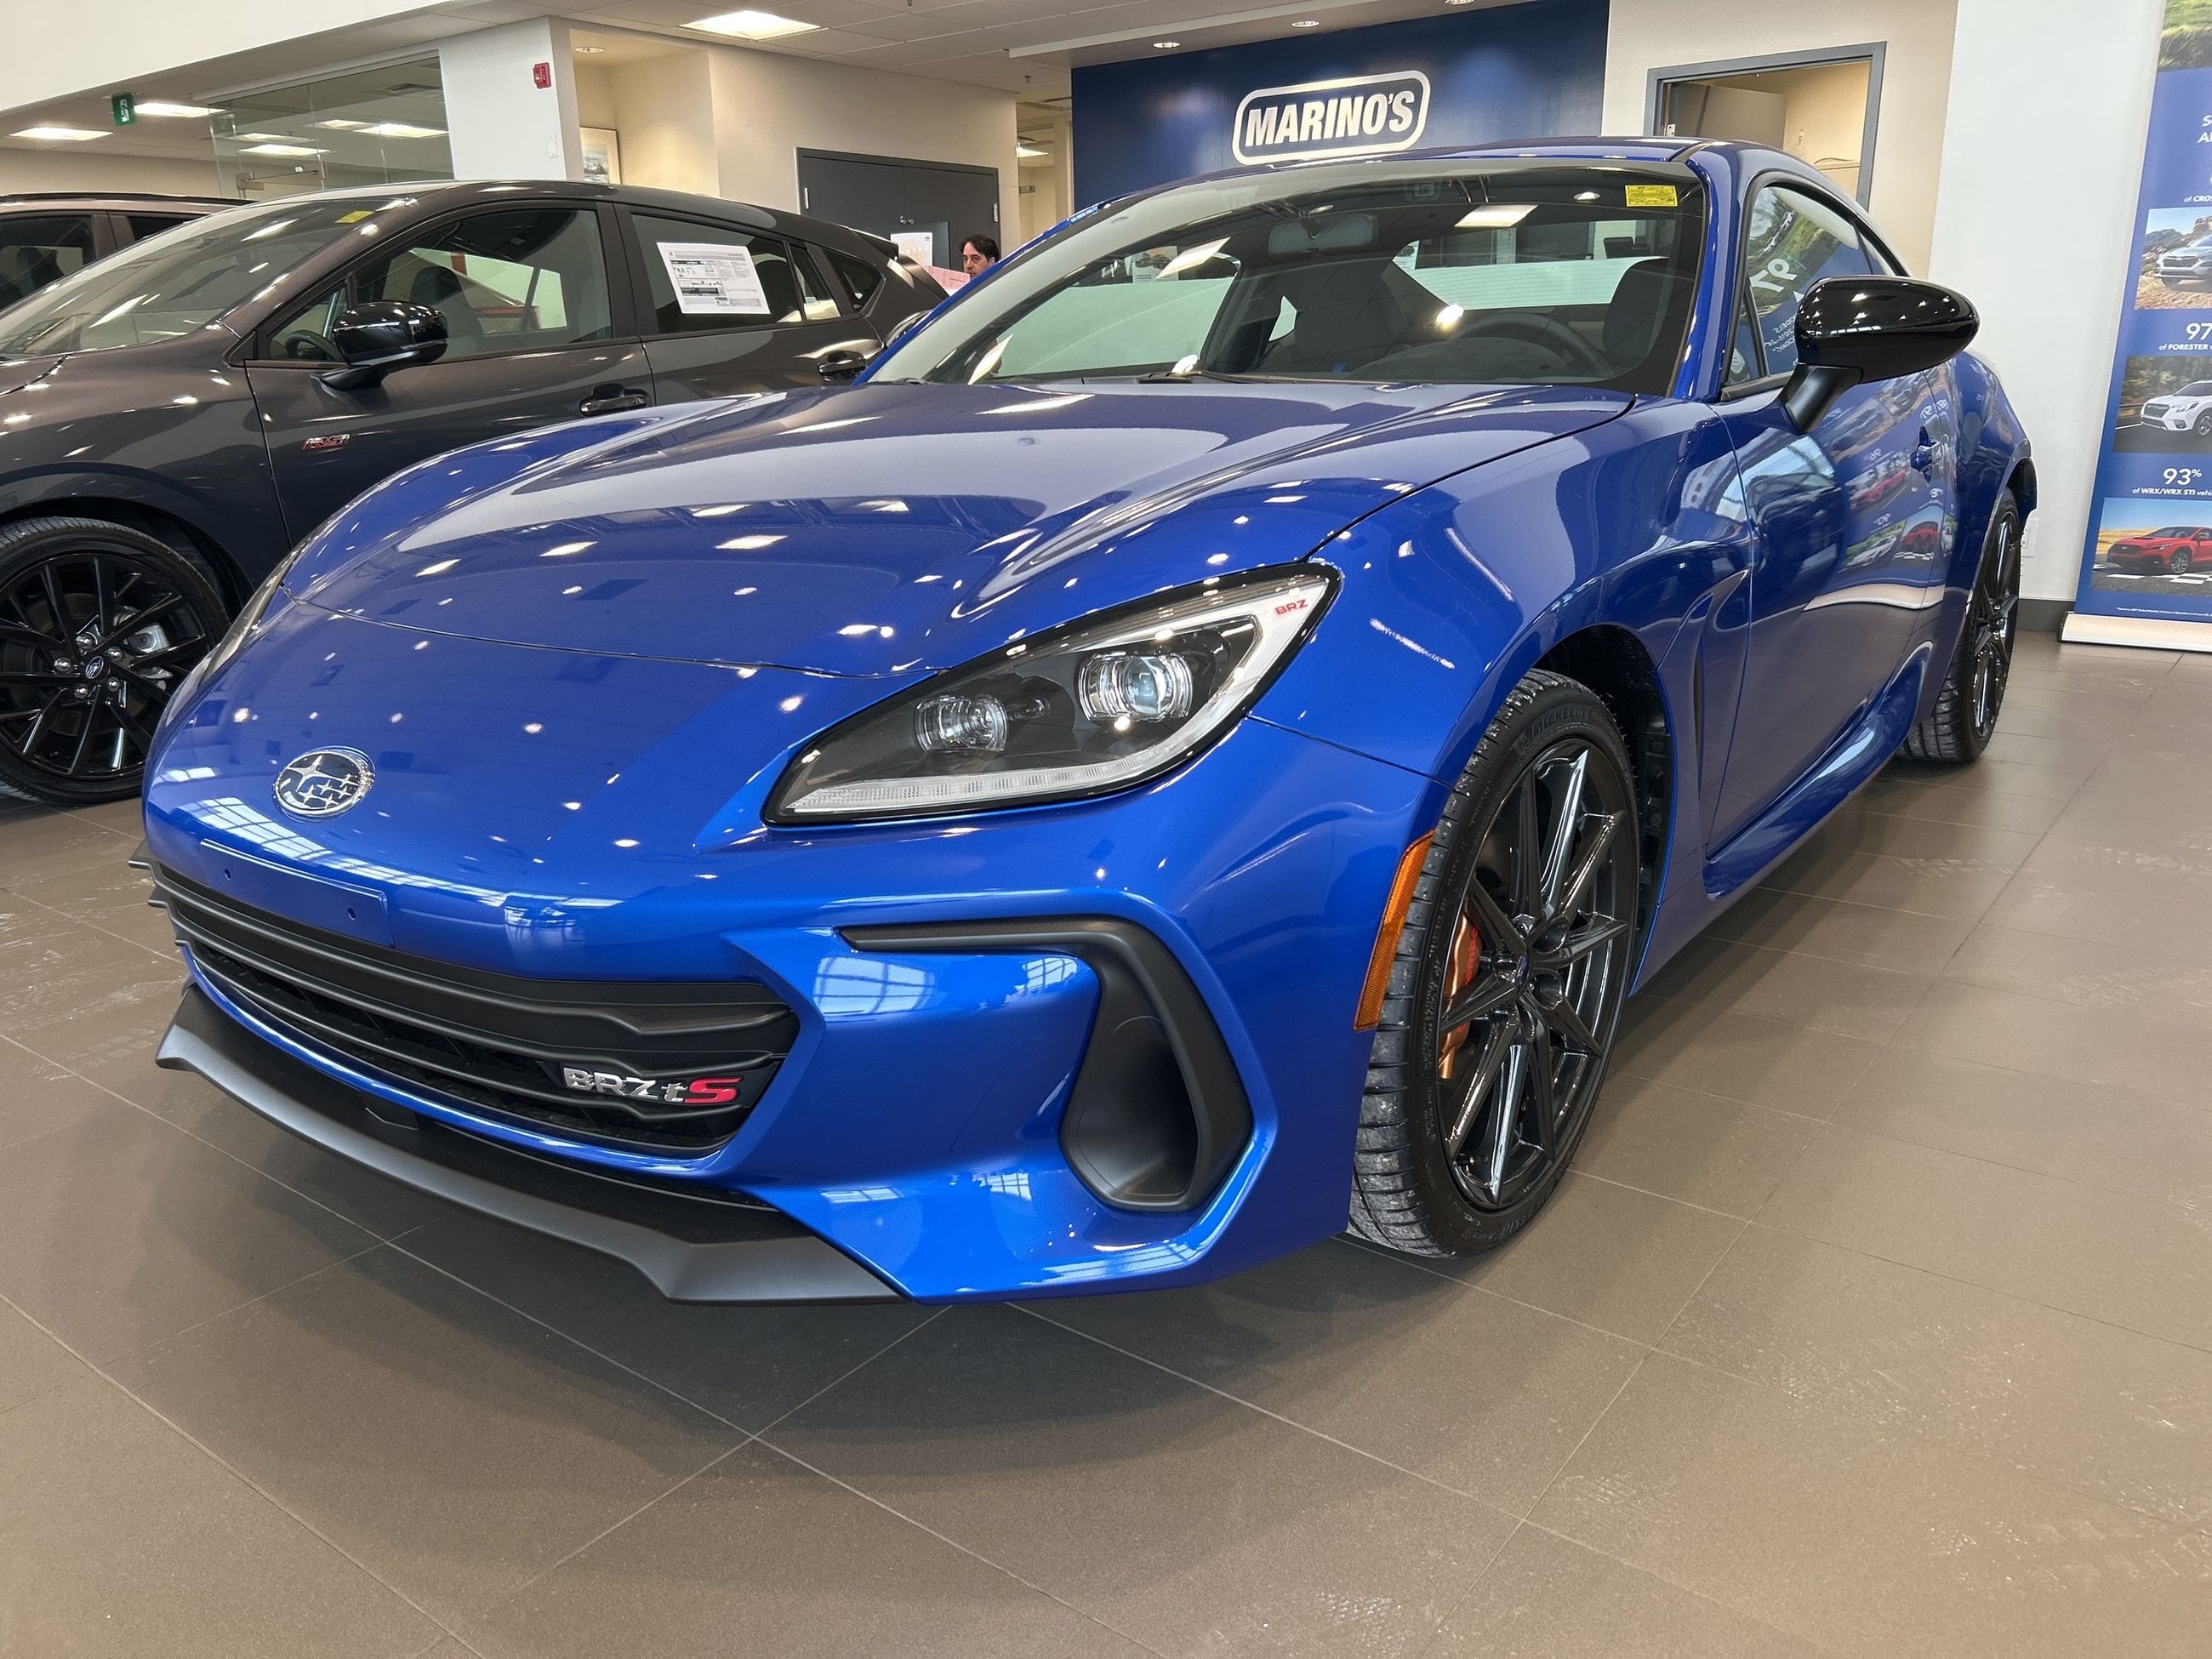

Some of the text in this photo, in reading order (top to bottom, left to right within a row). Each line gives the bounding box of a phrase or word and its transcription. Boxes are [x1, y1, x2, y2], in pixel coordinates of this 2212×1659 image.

[1245, 90, 1416, 147] MARINO'S
[2186, 322, 2212, 340] 97
[2163, 467, 2203, 486] 93%
[2141, 487, 2182, 496] WRX/WRX
[1275, 599, 1308, 614] BRZ
[562, 1067, 743, 1104] BRZ tS
